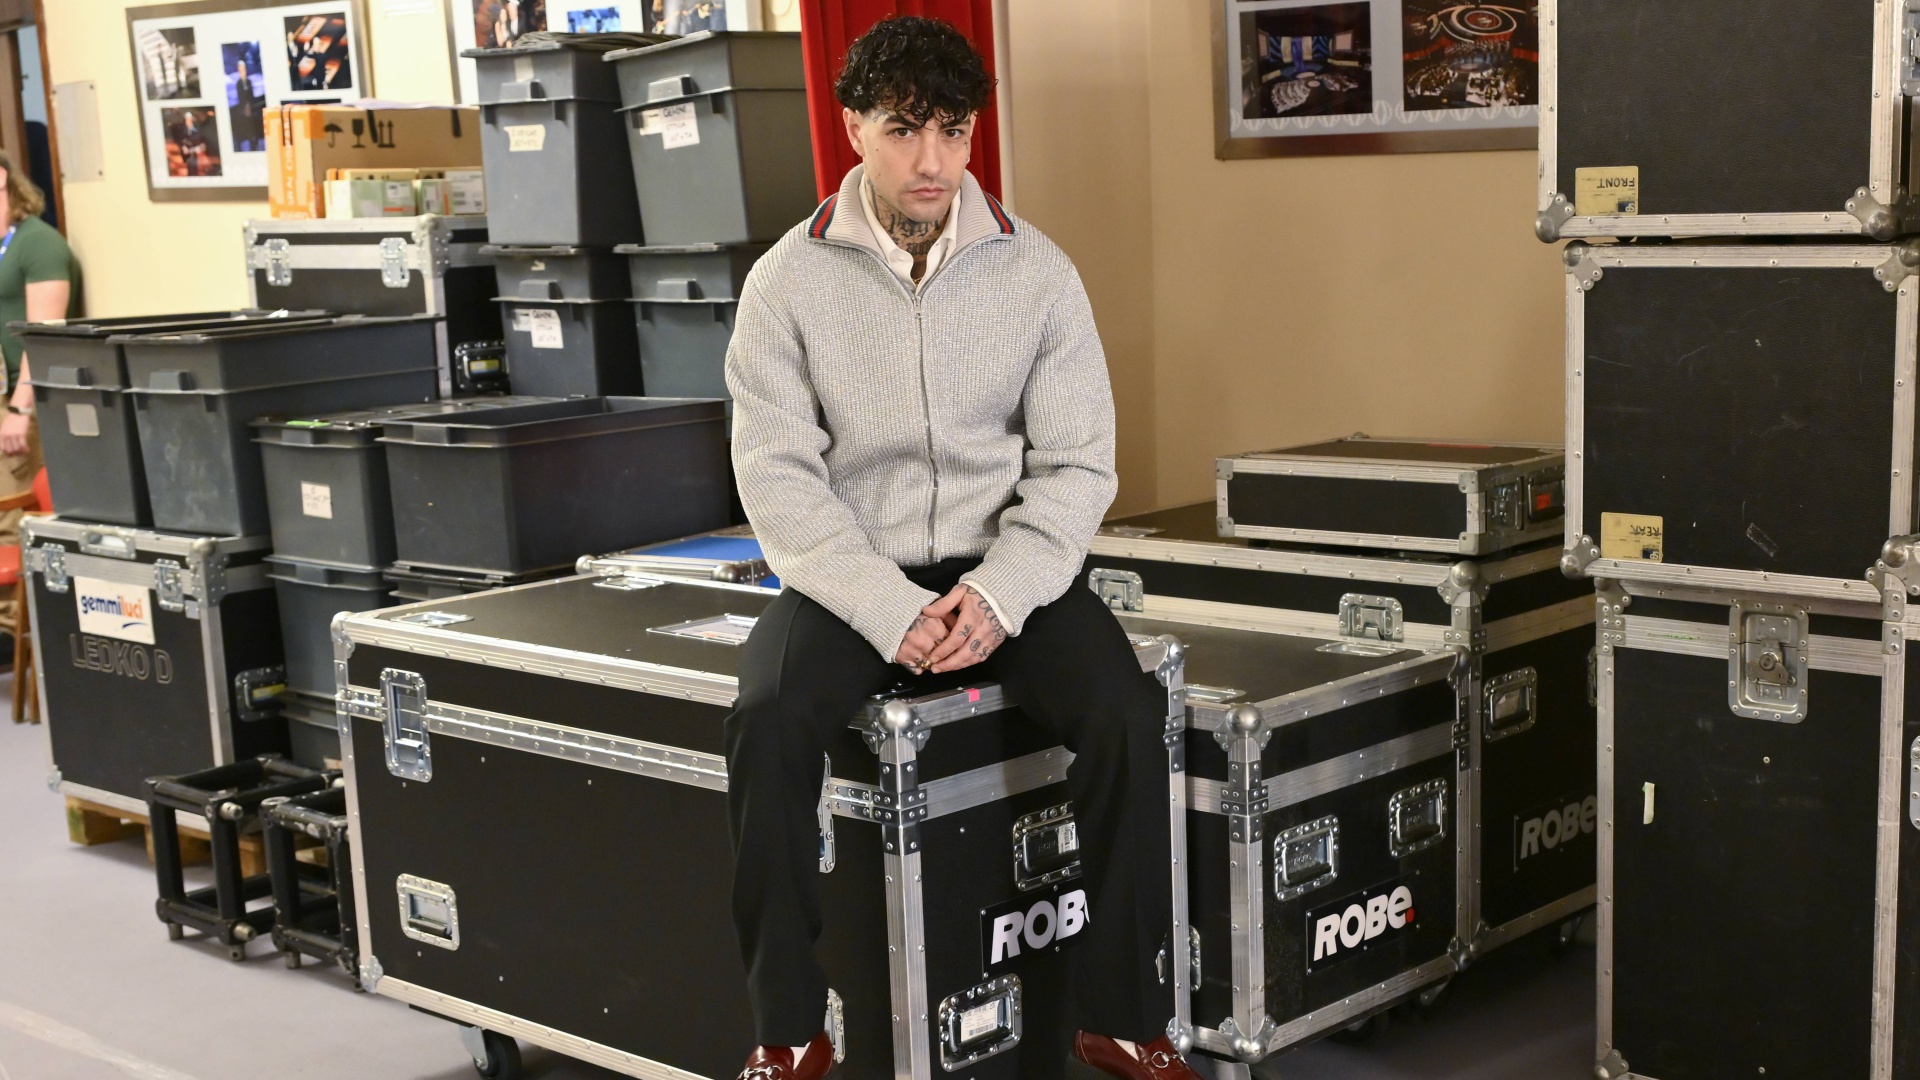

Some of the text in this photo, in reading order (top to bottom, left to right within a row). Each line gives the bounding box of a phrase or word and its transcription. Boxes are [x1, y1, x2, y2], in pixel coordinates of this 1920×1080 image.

[1596, 177, 1635, 189] FRONT
[1630, 525, 1660, 537] REAR
[81, 595, 143, 619] gemmiluci
[69, 633, 173, 685] LEDKO D
[990, 889, 1091, 965] ROB
